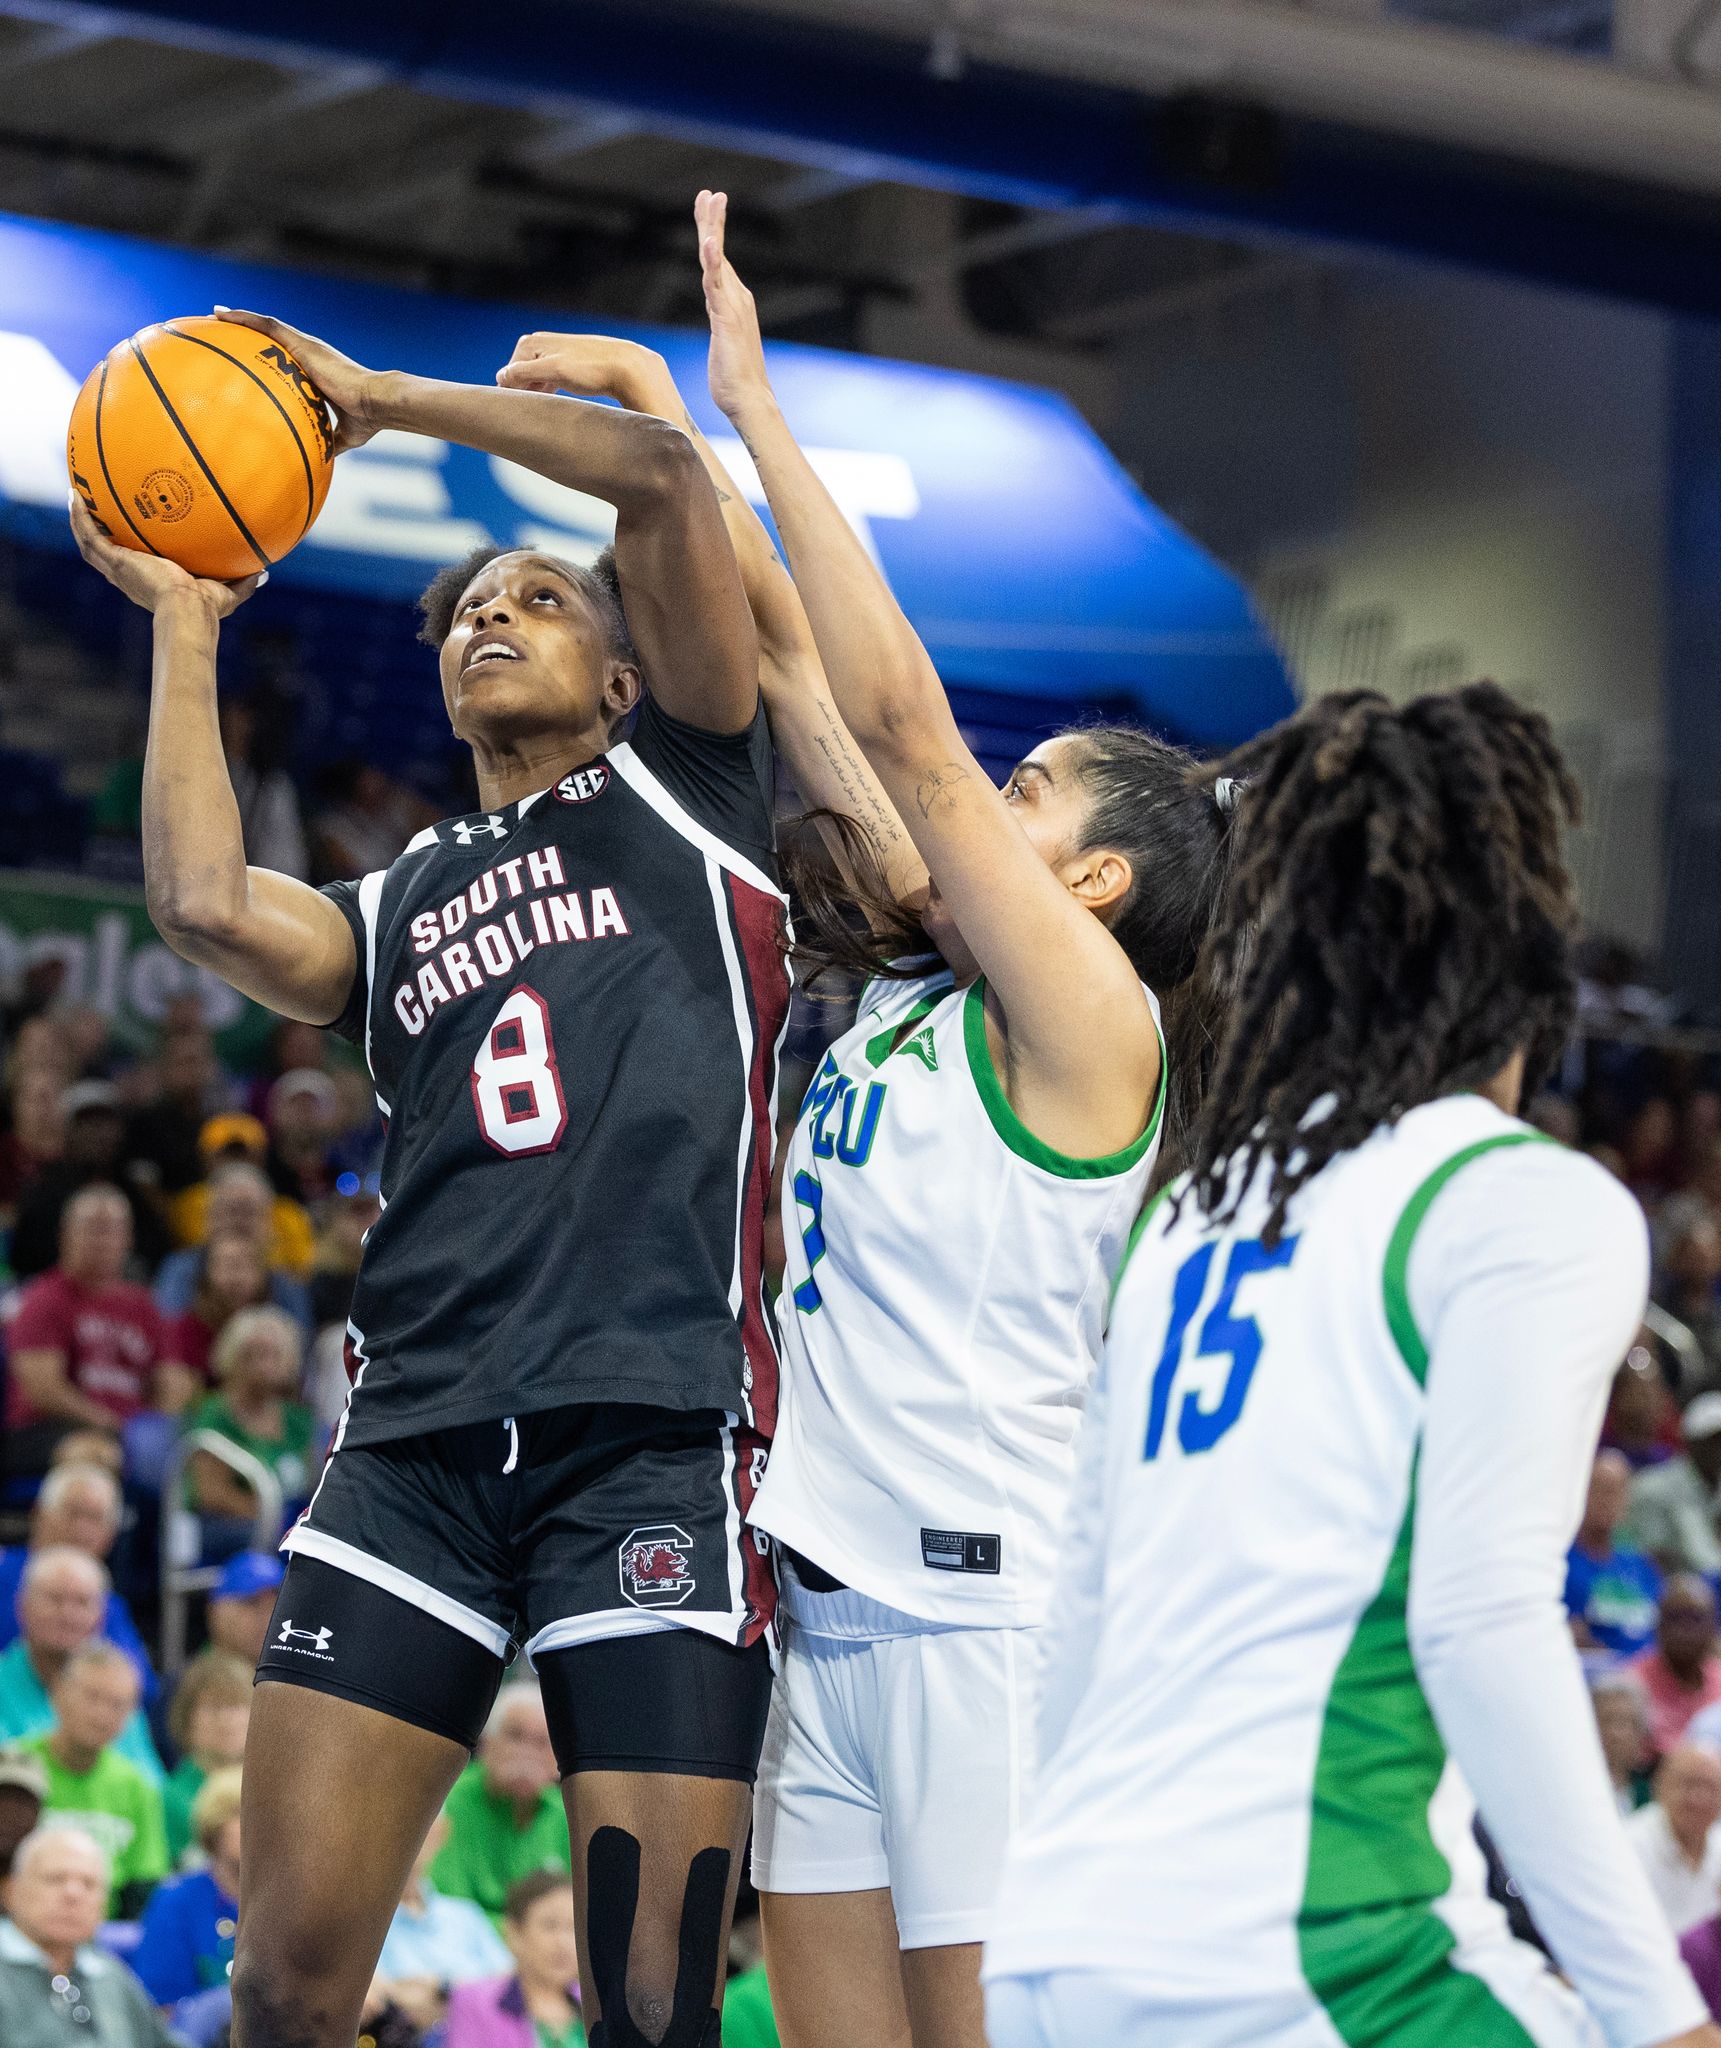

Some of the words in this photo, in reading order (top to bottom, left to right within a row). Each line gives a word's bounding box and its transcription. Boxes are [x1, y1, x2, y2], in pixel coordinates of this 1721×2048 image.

[254, 354, 297, 397] OFFICIAL
[557, 768, 605, 801] SEC
[410, 844, 568, 954] SOUTH
[393, 886, 632, 1036] CAROLINA
[470, 982, 569, 1162] 8
[1142, 1234, 1302, 1463] 15
[924, 1534, 963, 1544] ENGINEERED
[976, 1545, 985, 1561] L
[270, 1644, 293, 1652] UNDER
[294, 1648, 335, 1662] ARMOUR
